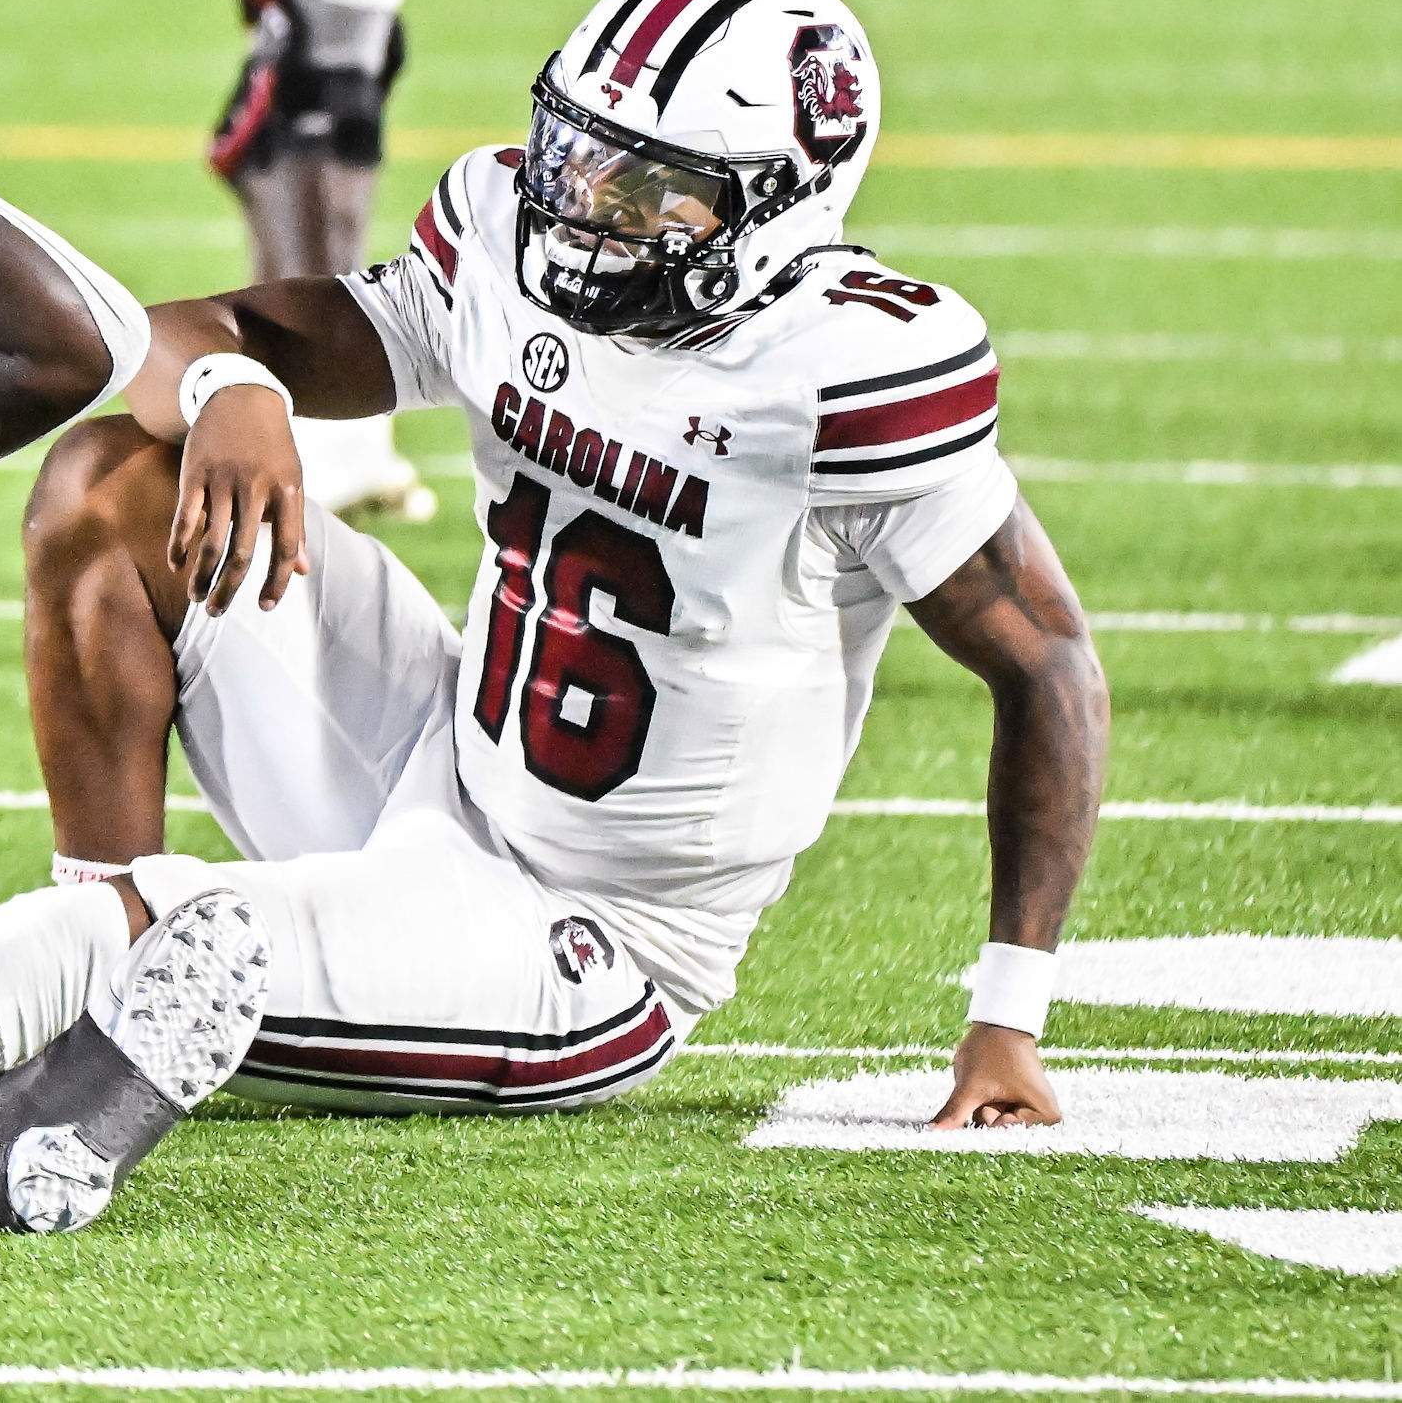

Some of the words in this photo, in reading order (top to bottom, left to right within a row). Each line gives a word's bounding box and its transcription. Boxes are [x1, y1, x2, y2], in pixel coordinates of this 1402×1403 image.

[822, 270, 942, 324] 16
[524, 335, 566, 390] SEC
[491, 381, 710, 539] CAROLINA
[474, 469, 675, 803] 16
